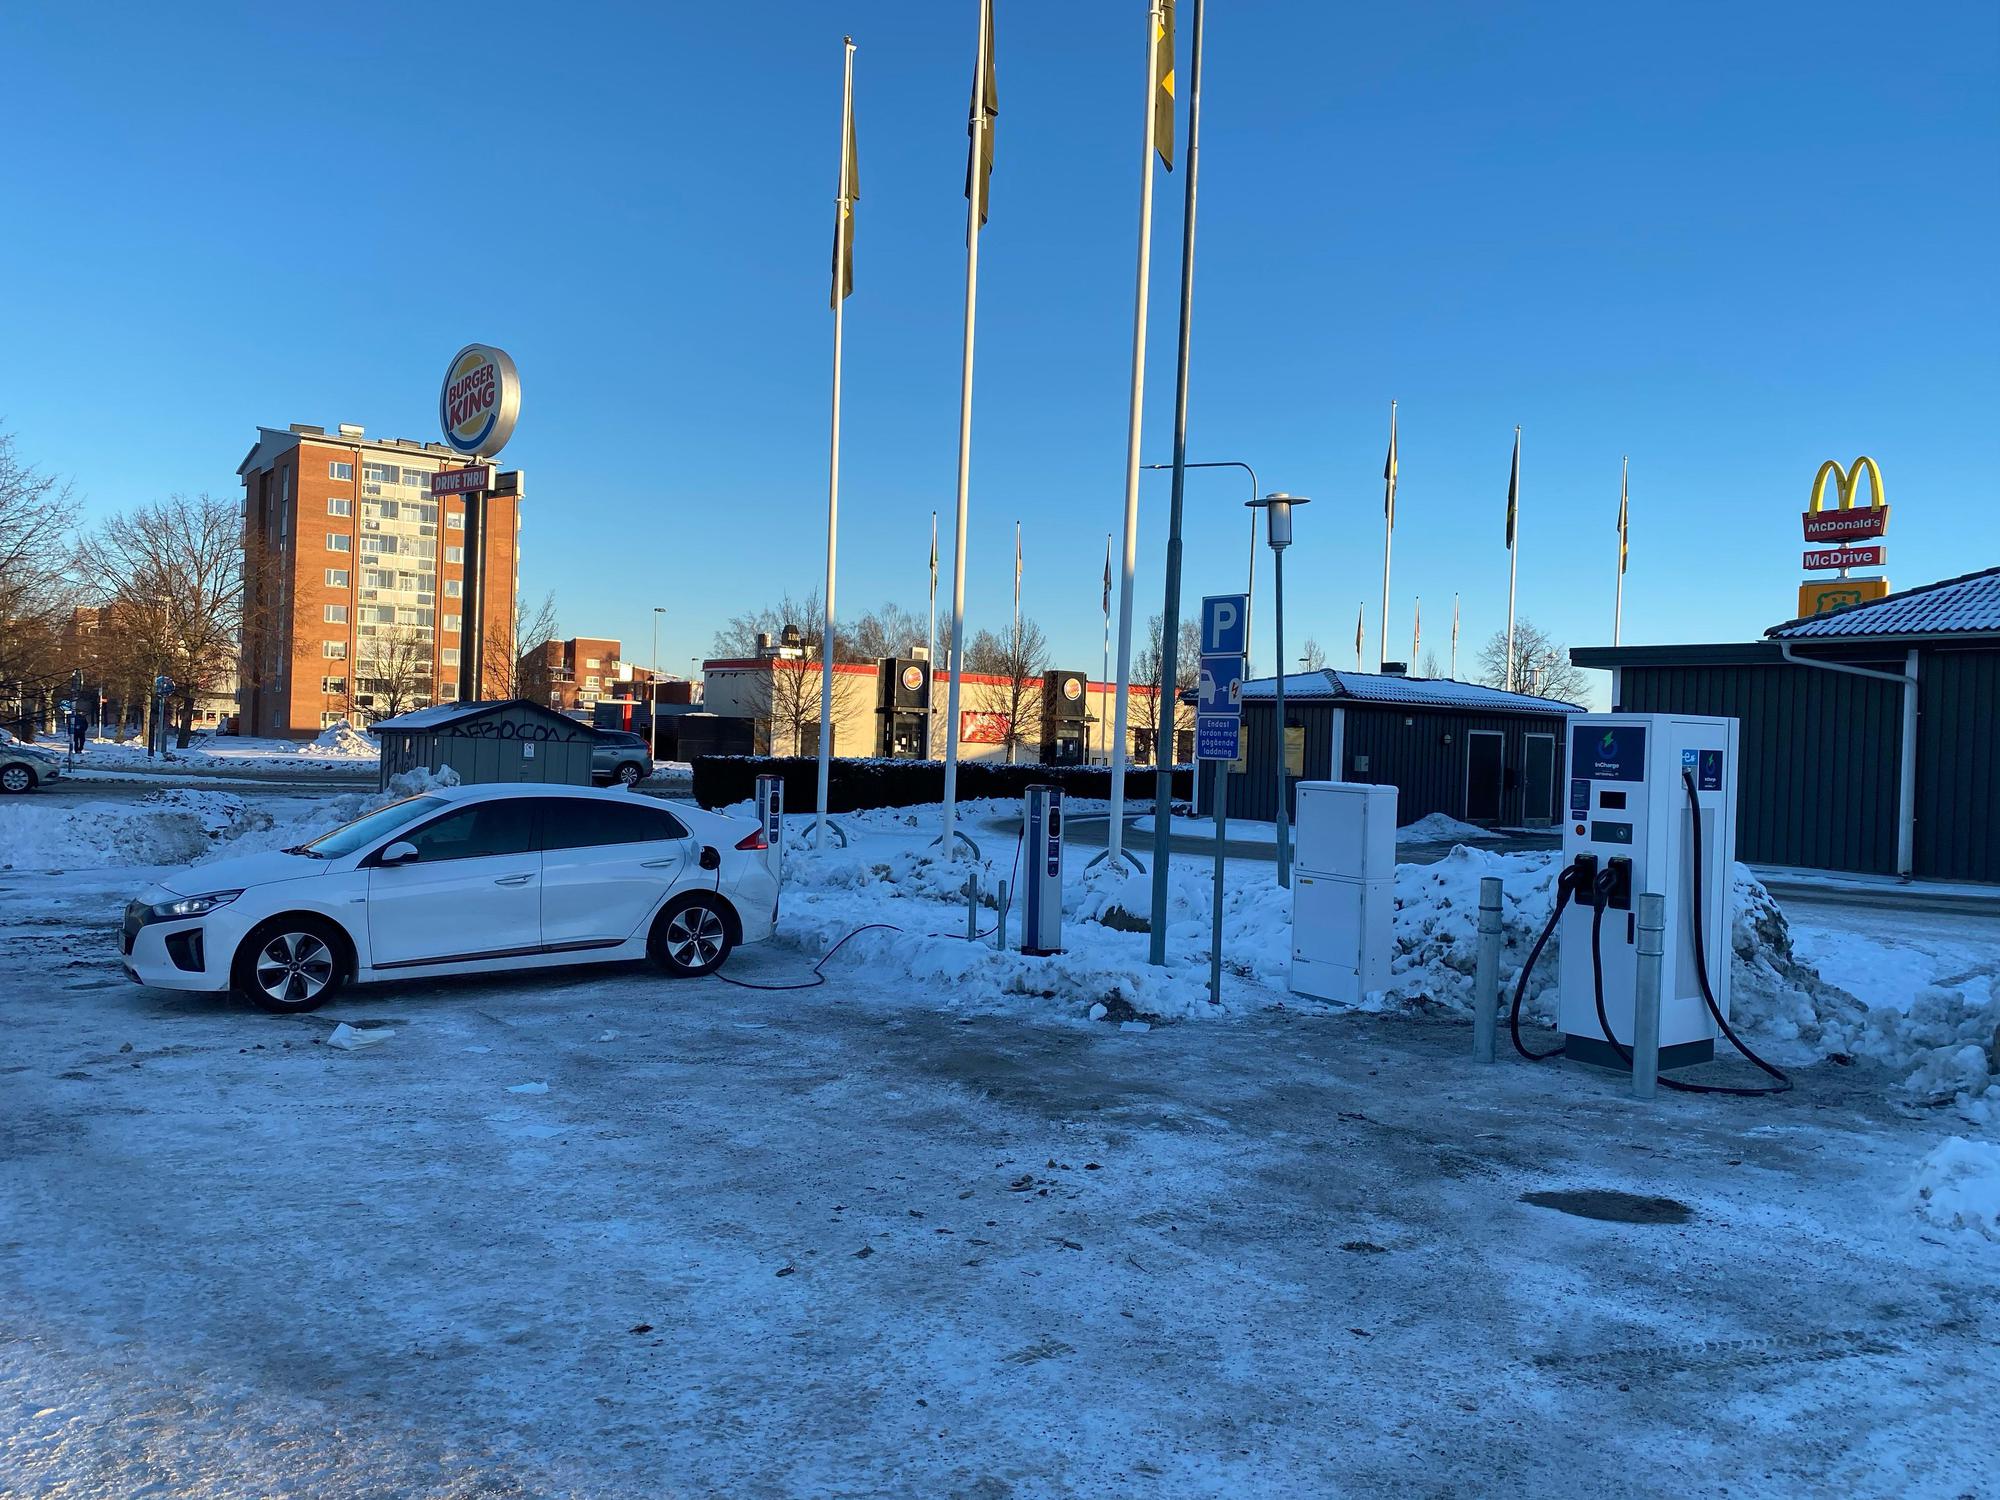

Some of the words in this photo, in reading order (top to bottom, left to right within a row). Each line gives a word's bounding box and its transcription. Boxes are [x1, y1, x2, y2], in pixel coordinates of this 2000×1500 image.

[449, 363, 494, 407] BURGER
[449, 381, 495, 431] KING
[435, 475, 460, 491] DRIVE
[463, 470, 485, 488] THRU
[1807, 517, 1881, 533] McDonald's
[1805, 551, 1873, 567] McDrive
[1212, 602, 1237, 649] P
[1207, 720, 1231, 728] Endast
[1200, 729, 1222, 737] fordon
[1223, 730, 1238, 738] med
[1201, 739, 1235, 747] pågående
[1203, 748, 1232, 757] laddning
